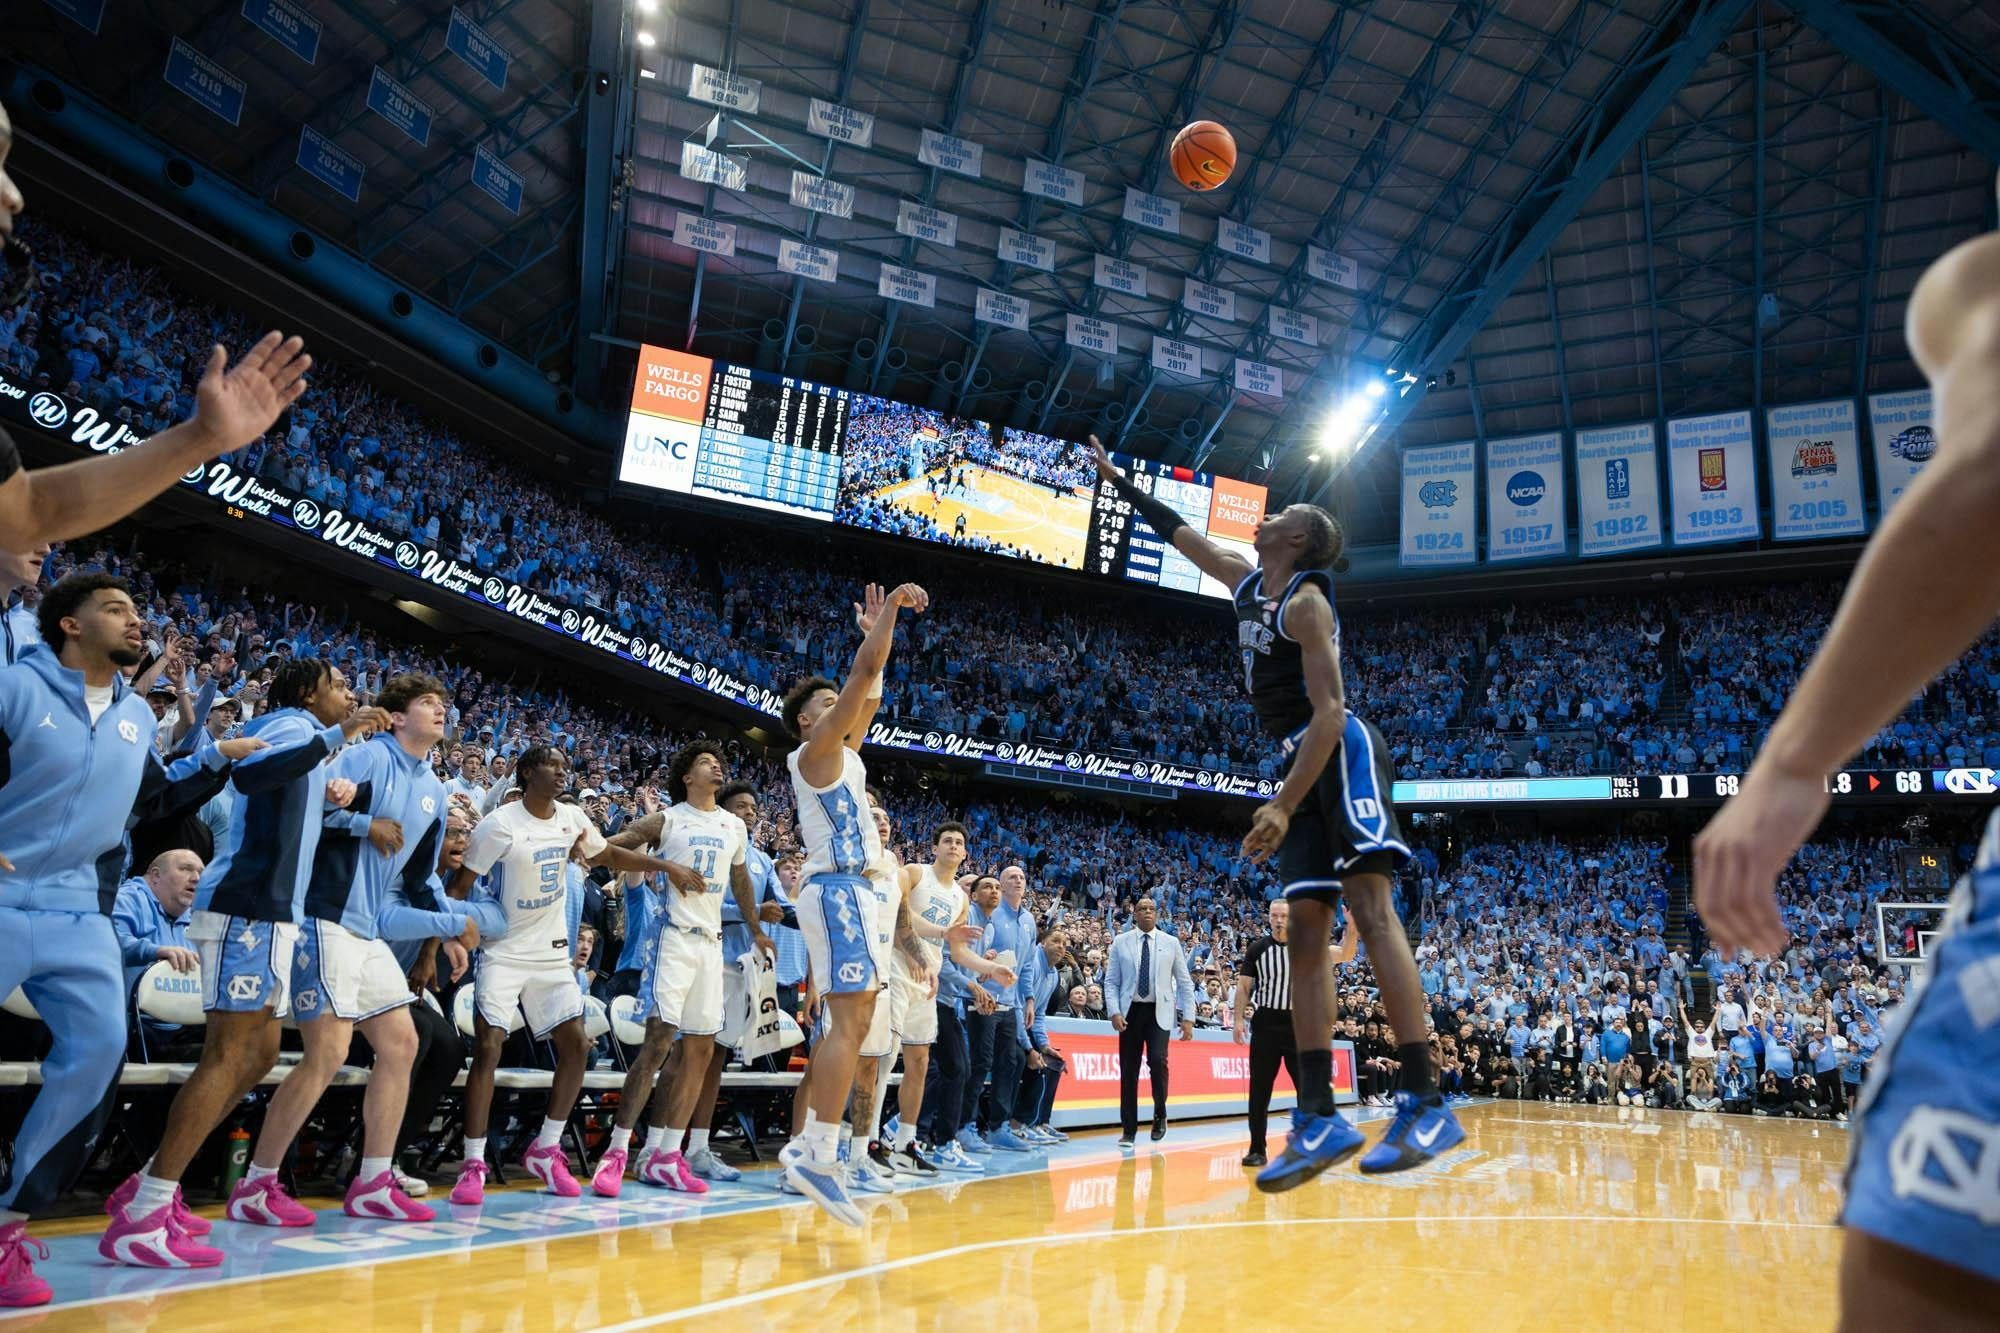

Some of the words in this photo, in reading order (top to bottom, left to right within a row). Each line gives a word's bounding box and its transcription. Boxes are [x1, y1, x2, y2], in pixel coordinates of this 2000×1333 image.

[466, 35, 491, 62] 1994
[193, 53, 243, 93] CHAMPIONS
[703, 76, 726, 90] FINAL
[387, 91, 415, 119] 2007
[828, 124, 853, 140] 1957
[317, 151, 345, 177] 2024
[685, 223, 705, 235] FINAL
[1200, 301, 1219, 315] 1997
[1075, 324, 1093, 334] FINAL
[1081, 335, 1103, 349] 2016
[1161, 346, 1179, 357] FINAL
[647, 363, 702, 387] WELLS
[1167, 359, 1187, 372] 2017
[1243, 369, 1260, 379] FINAL
[644, 380, 700, 403] FARGO
[723, 375, 752, 390] FOSTER
[728, 365, 751, 378] PLAYER
[782, 377, 795, 388] PTS
[818, 386, 831, 396] AST
[837, 390, 849, 400] FLS
[1249, 378, 1270, 392] 2022
[722, 386, 747, 401] EVANS
[1774, 408, 1834, 423] University
[1837, 404, 1848, 416] of
[705, 417, 715, 428] 12
[772, 432, 786, 443] 24
[1675, 418, 1731, 434] University
[1734, 416, 1745, 427] of
[1803, 421, 1853, 436] Carolina
[634, 432, 688, 460] UNC
[1703, 431, 1750, 446] Carolina
[1799, 447, 1836, 459] FINAL
[208, 463, 292, 507] Window
[1133, 473, 1153, 494] 68
[1158, 478, 1177, 499] 68
[1510, 486, 1547, 499] NCAA
[1096, 497, 1132, 515] 28-62
[1217, 492, 1260, 512] WELLS
[1788, 500, 1847, 521] 2005
[1098, 513, 1125, 529] 7-19
[1215, 508, 1258, 526] FARGO
[1593, 514, 1648, 537] 1982
[1687, 507, 1743, 528] 1993
[323, 509, 394, 550] Window
[1099, 531, 1120, 545] 5-6
[1502, 524, 1553, 545] 1957
[1414, 532, 1464, 550] 1924
[1099, 545, 1116, 559] 38
[421, 550, 483, 586] Window
[1101, 561, 1110, 575] 8
[1127, 568, 1159, 582] TURNOVERS
[506, 585, 560, 617] Window
[581, 616, 630, 646] Window
[648, 643, 691, 672] Window
[707, 668, 746, 694] Window
[870, 722, 922, 746] Window
[944, 734, 995, 757] Window
[1015, 744, 1064, 766] Window
[1084, 753, 1131, 776] Window
[1150, 763, 1195, 785] Window
[1213, 772, 1256, 793] Window
[1613, 777, 1631, 787] TOL:
[1715, 775, 1739, 796] 68
[1895, 771, 1922, 794] 68
[1613, 788, 1632, 798] FLS:
[1632, 788, 1640, 798] 6
[688, 836, 725, 850] NORTH
[693, 849, 717, 879] 11
[540, 863, 560, 893] 5
[1073, 1054, 1121, 1081] WELLS
[1210, 1057, 1243, 1079] WELLS
